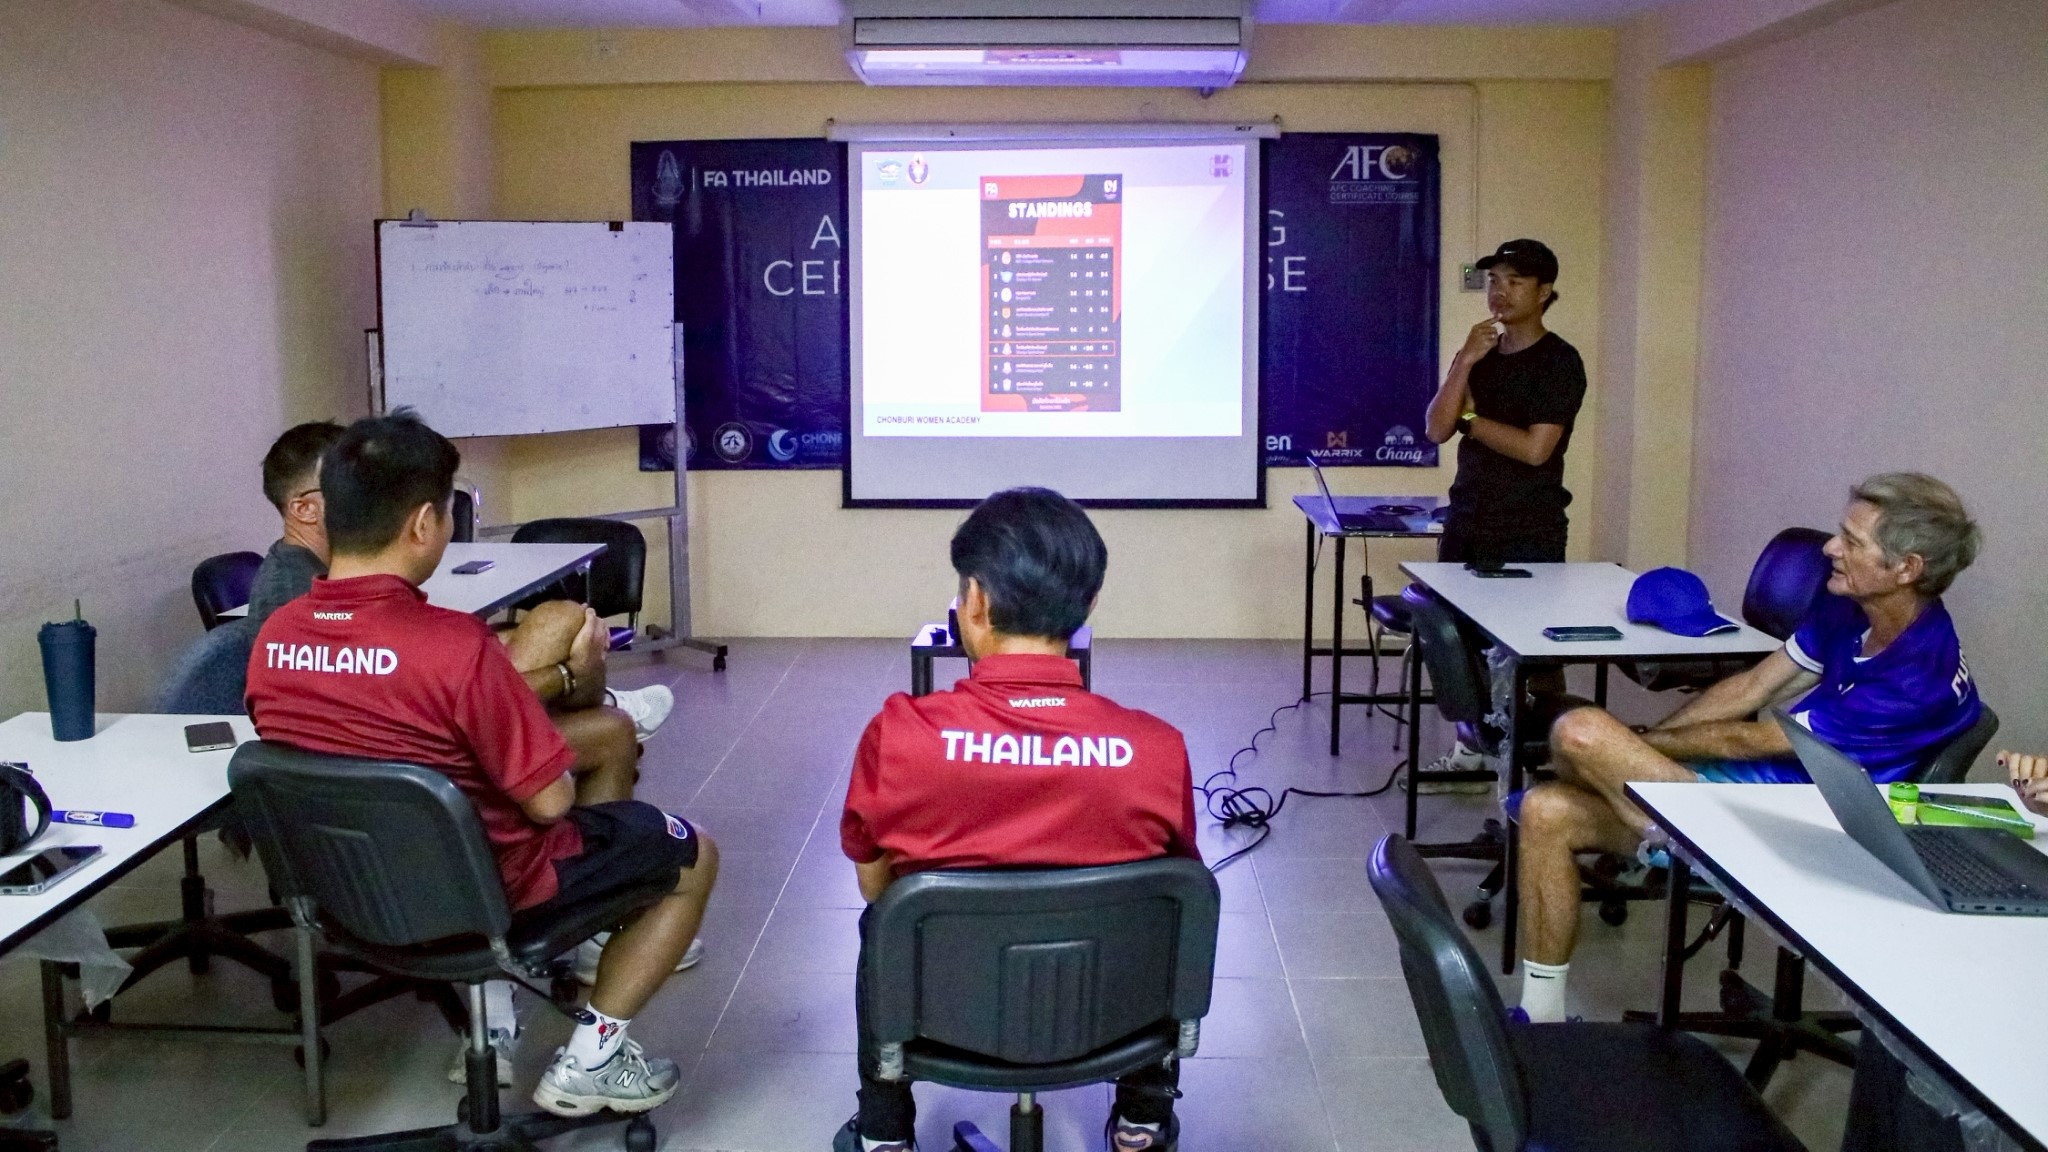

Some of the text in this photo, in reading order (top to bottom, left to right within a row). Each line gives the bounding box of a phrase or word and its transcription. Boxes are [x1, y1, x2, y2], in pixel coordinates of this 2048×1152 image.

[1330, 145, 1409, 180] AFC
[704, 169, 832, 187] FA THAILAND
[1329, 184, 1396, 192] AFC COACHING
[1329, 192, 1420, 200] CERTIFICATE COURSE
[1008, 201, 1093, 219] STANDINGS
[763, 260, 841, 296] CE
[877, 415, 982, 424] CHONBURI WOMEN ACADEMY
[1310, 449, 1363, 458] WARRIX
[1375, 446, 1423, 462] Chang
[313, 612, 354, 620] WARRIX
[266, 642, 398, 675] THAILAND
[1009, 697, 1066, 708] WARRIX
[941, 730, 1134, 768] THAILAND
